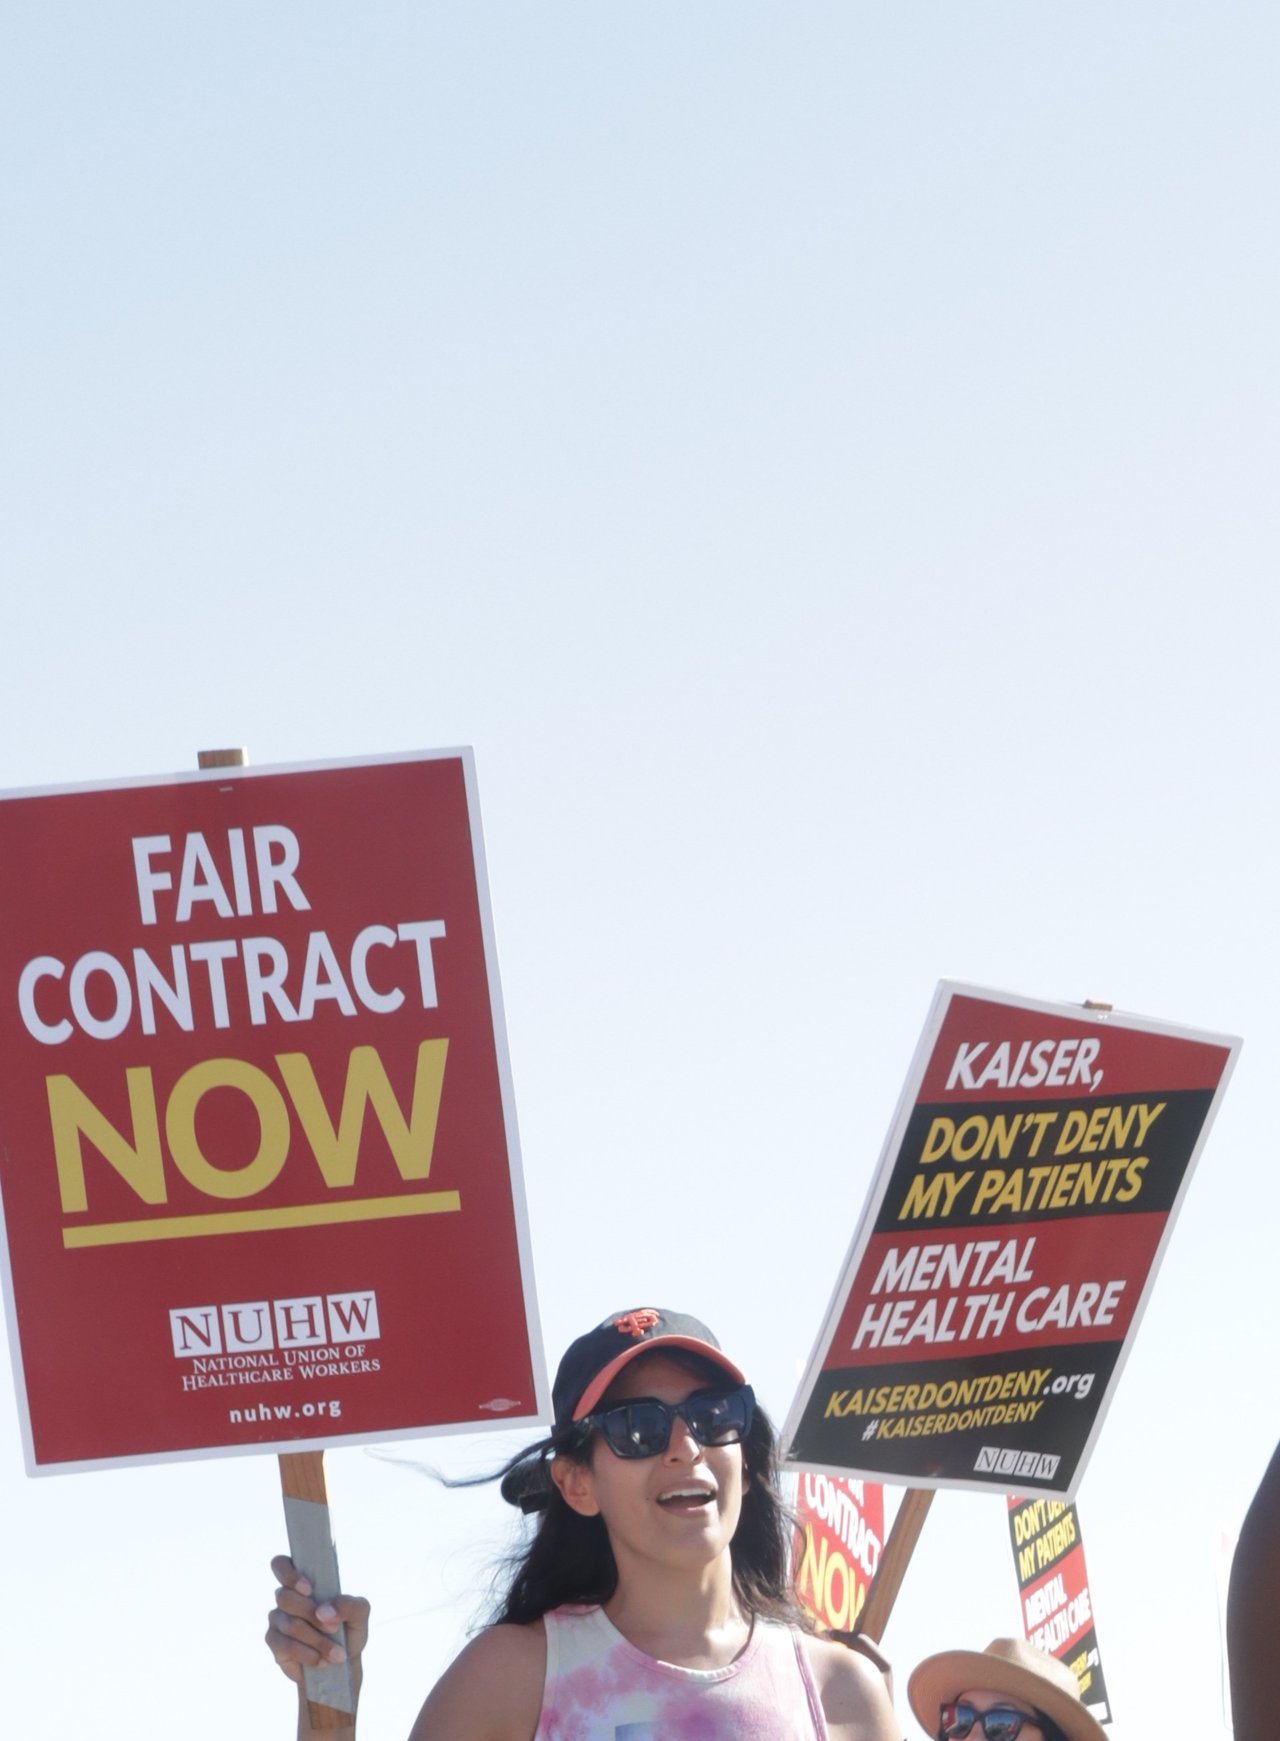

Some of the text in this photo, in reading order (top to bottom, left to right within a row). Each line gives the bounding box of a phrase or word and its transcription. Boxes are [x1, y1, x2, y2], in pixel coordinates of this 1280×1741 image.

[132, 824, 312, 925] FAIR
[18, 919, 448, 1045] CONTRACT
[945, 1038, 1105, 1092] KAISER,
[45, 1037, 450, 1214] NOW
[919, 1102, 1167, 1165] DON’T DENY
[898, 1157, 1150, 1221] MY PATIENTS
[870, 1237, 1036, 1295] MENTAL
[174, 1295, 376, 1353] NUHW
[851, 1280, 1127, 1350] HEALTH CARE
[182, 1358, 381, 1391] HEALTHCARE WORKERS
[193, 1344, 367, 1375] NATIONAL UNION OF
[229, 1400, 342, 1424] nuhw.org
[823, 1368, 1096, 1419] KAISERDONTDENY.org
[861, 1401, 1044, 1441] #KAISERDONTDENY
[974, 1447, 1062, 1479] NUHW
[1047, 1500, 1069, 1523] DE
[1018, 1511, 1076, 1583] MY PATIENTS
[1025, 1572, 1068, 1631] MENTAL
